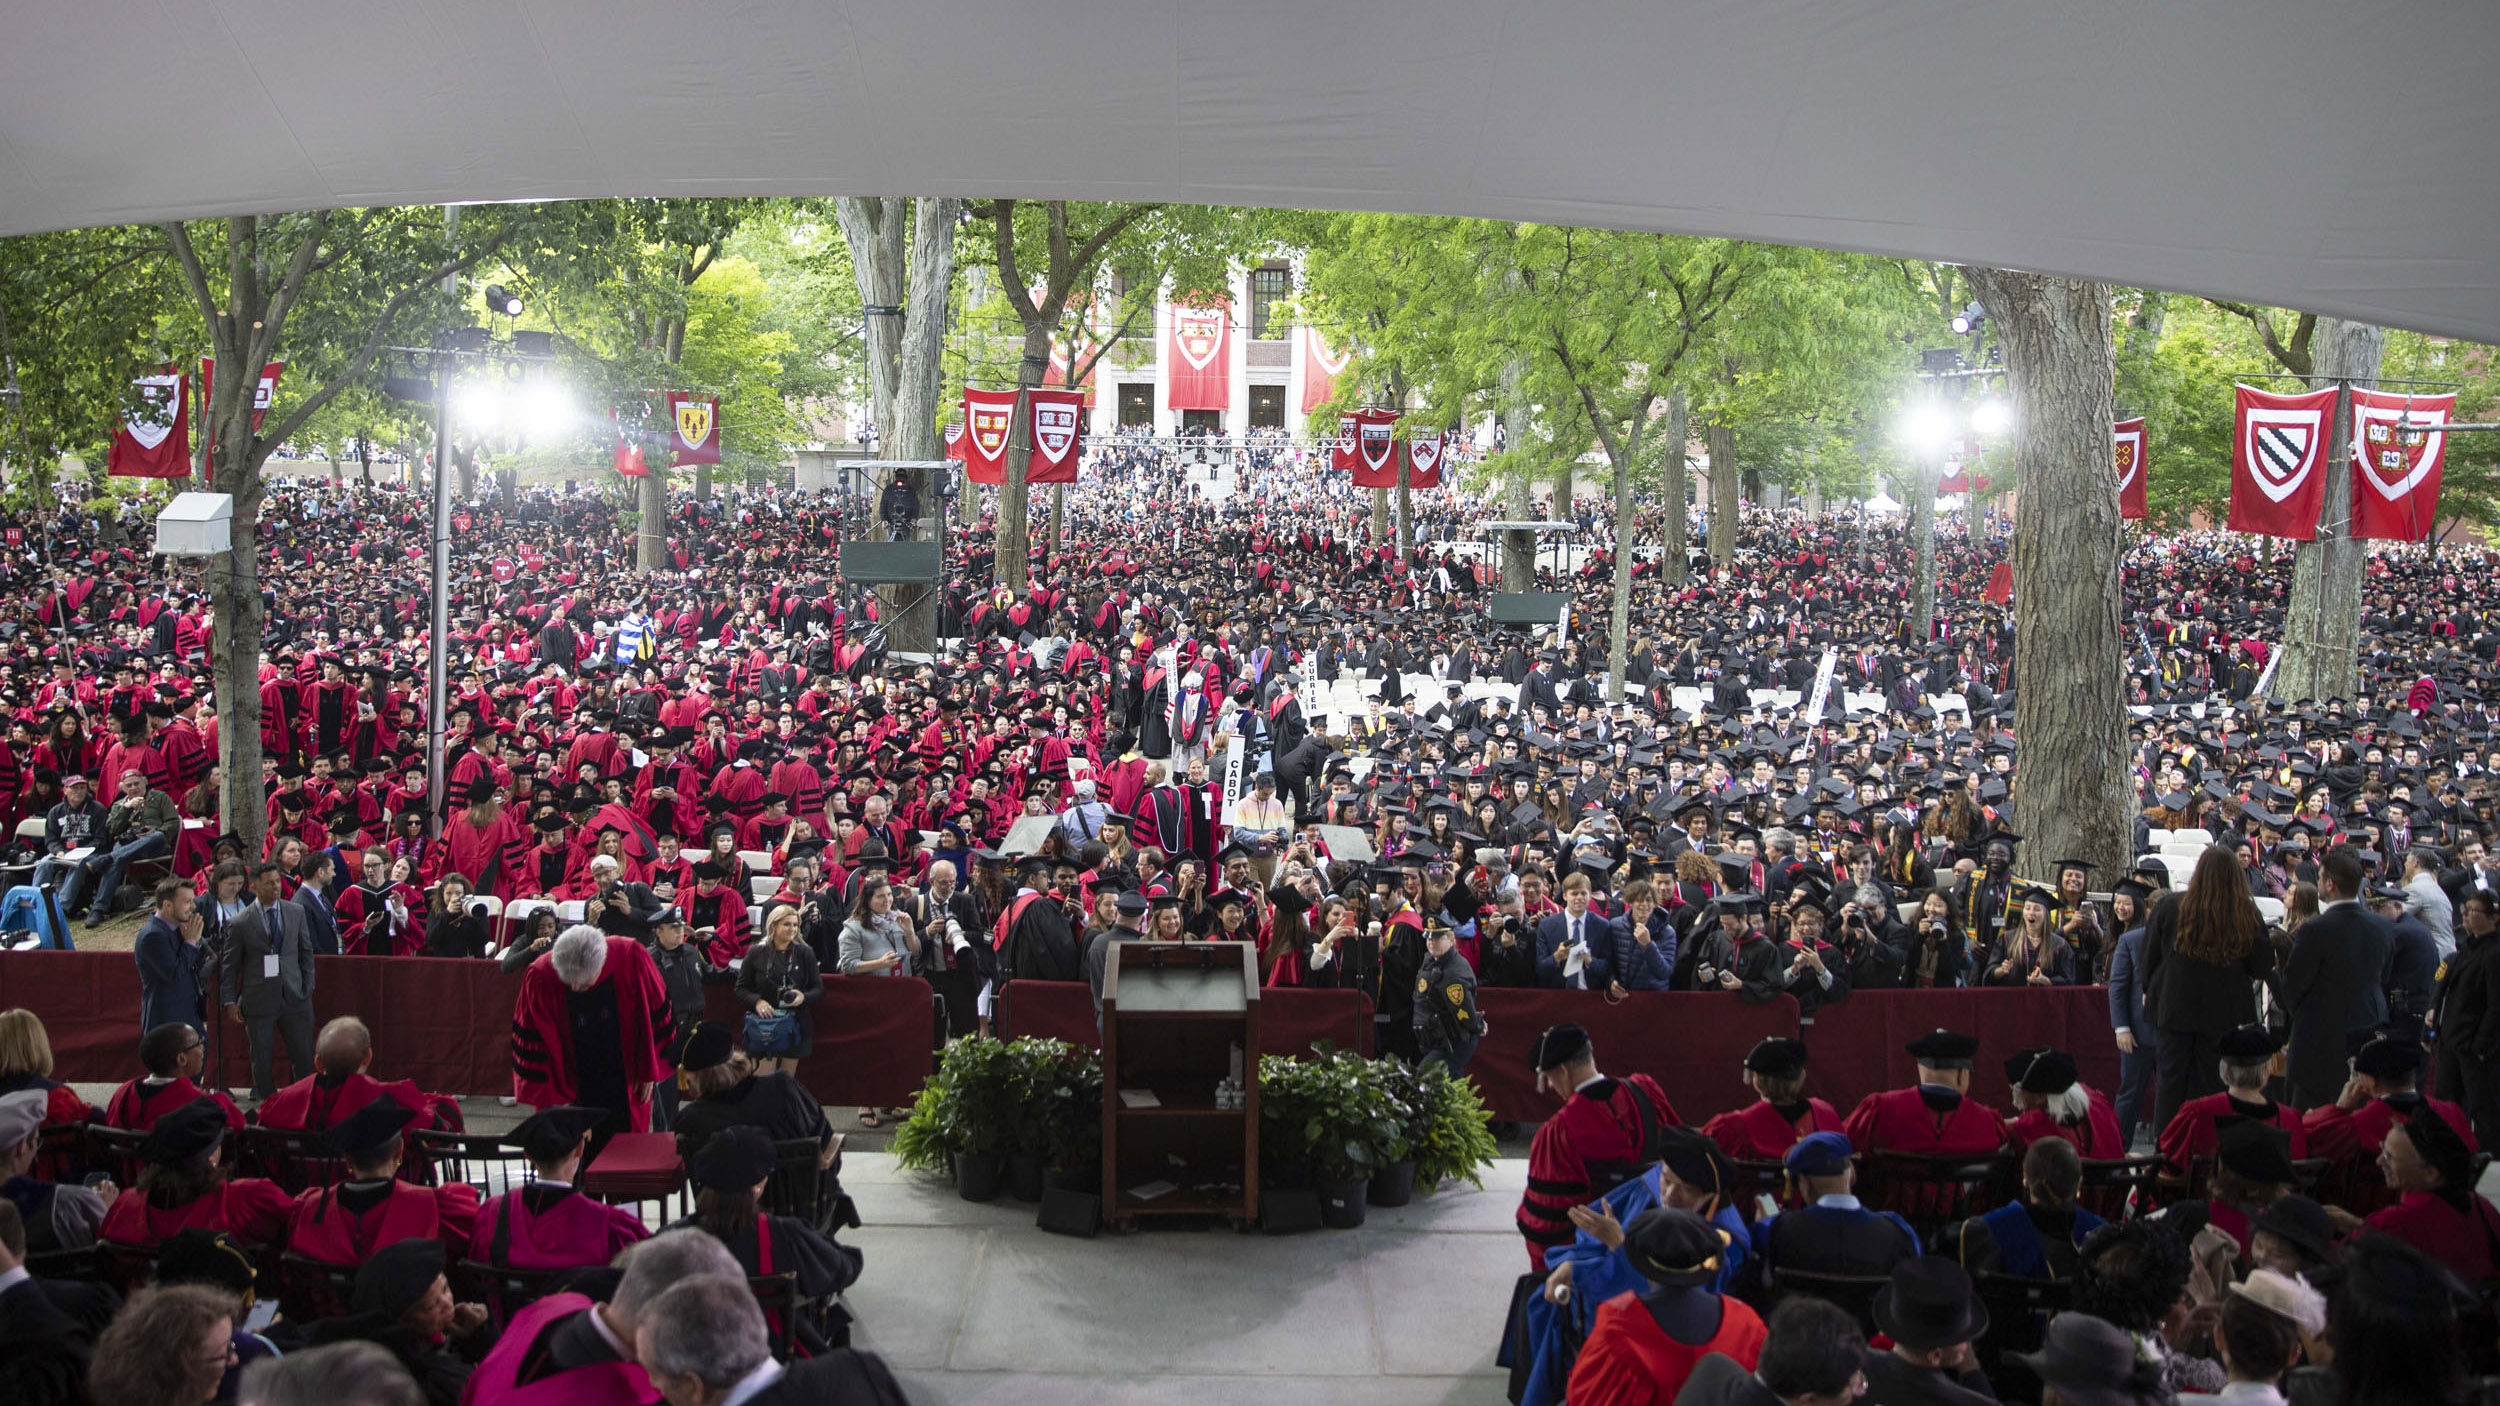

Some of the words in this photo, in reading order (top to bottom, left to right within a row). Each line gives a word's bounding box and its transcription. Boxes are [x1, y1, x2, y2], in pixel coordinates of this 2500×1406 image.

[2372, 428, 2386, 437] VE
[2383, 454, 2399, 463] TAS
[1308, 660, 1317, 710] CURRIER
[1811, 671, 1825, 709] ADAMS
[1227, 760, 1239, 807] CABOT
